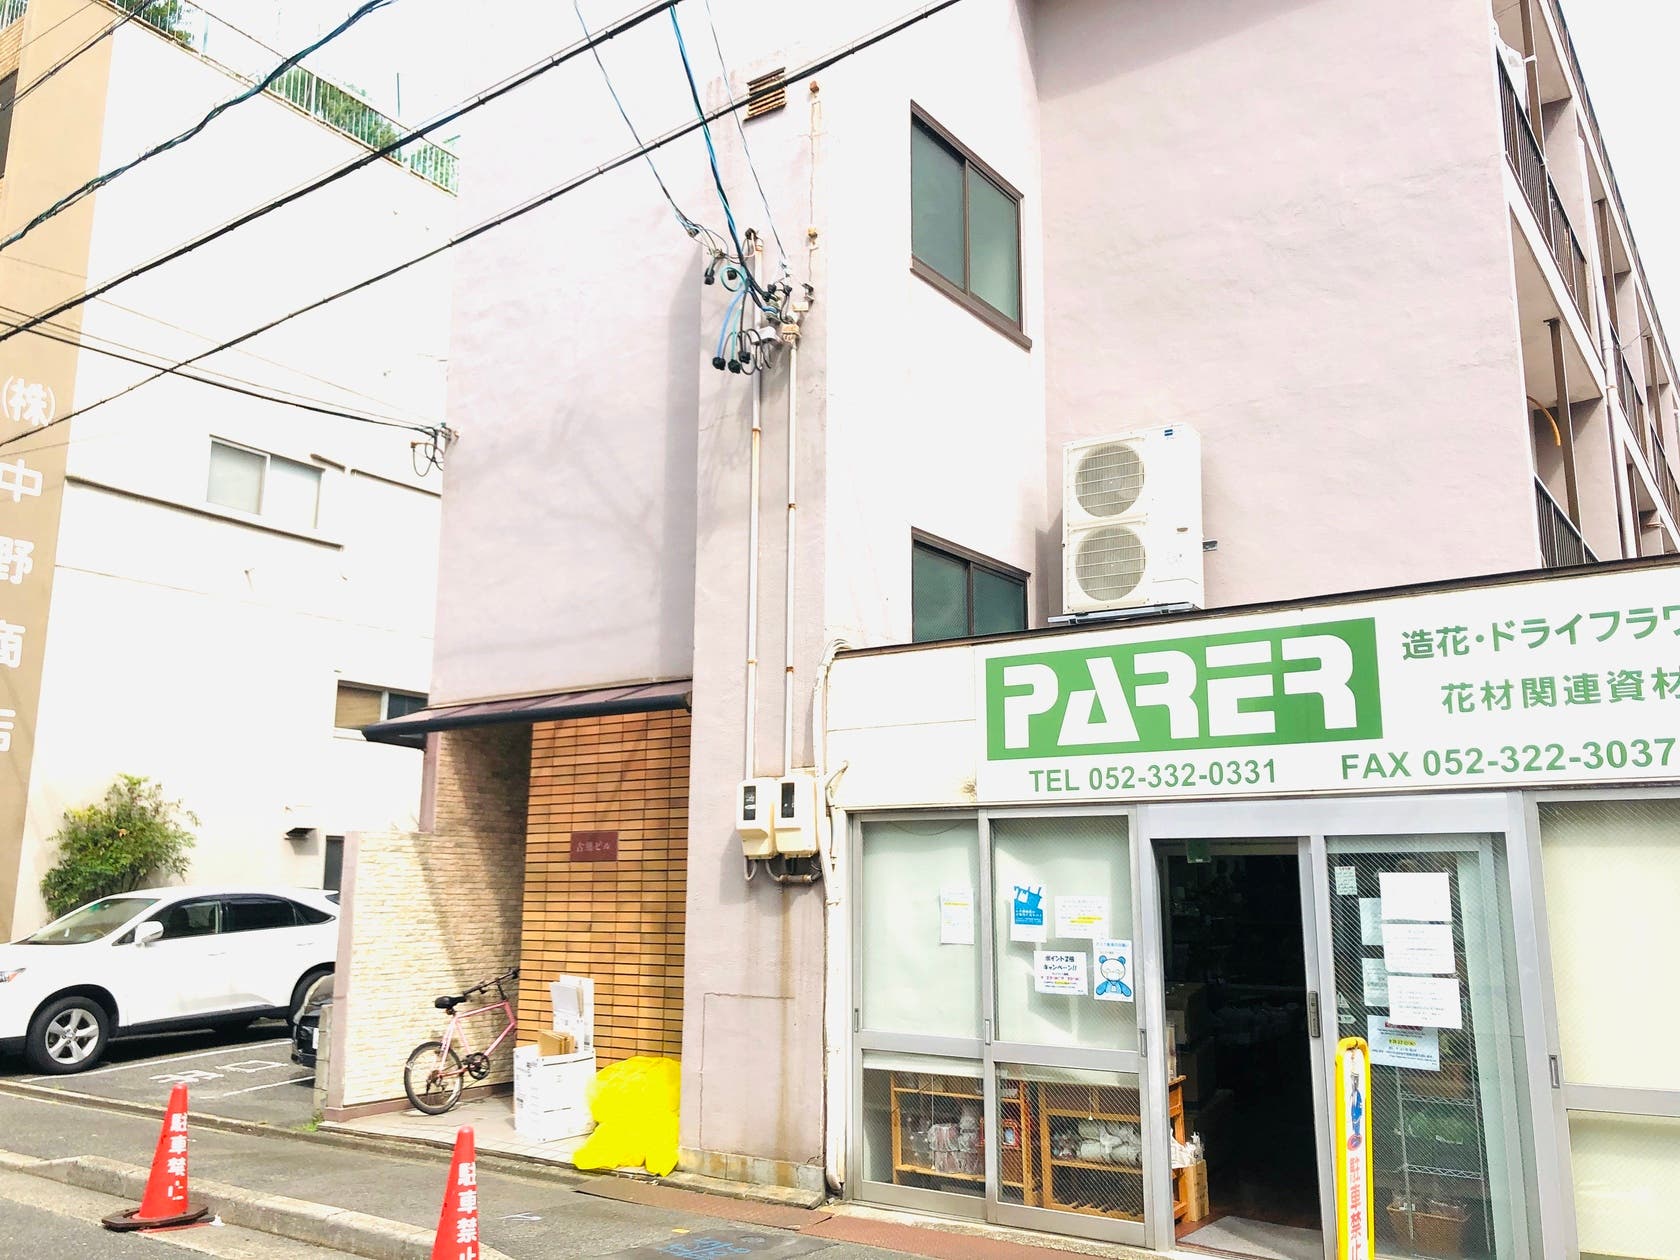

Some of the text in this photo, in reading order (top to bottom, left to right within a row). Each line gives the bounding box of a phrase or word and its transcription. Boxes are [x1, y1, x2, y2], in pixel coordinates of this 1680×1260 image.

[1003, 634, 1358, 750] PARER
[1440, 666, 1680, 715] 花材関連資材
[1029, 757, 1276, 792] TEL 052-332-0331
[1341, 737, 1677, 780] FAX 052-322-3037
